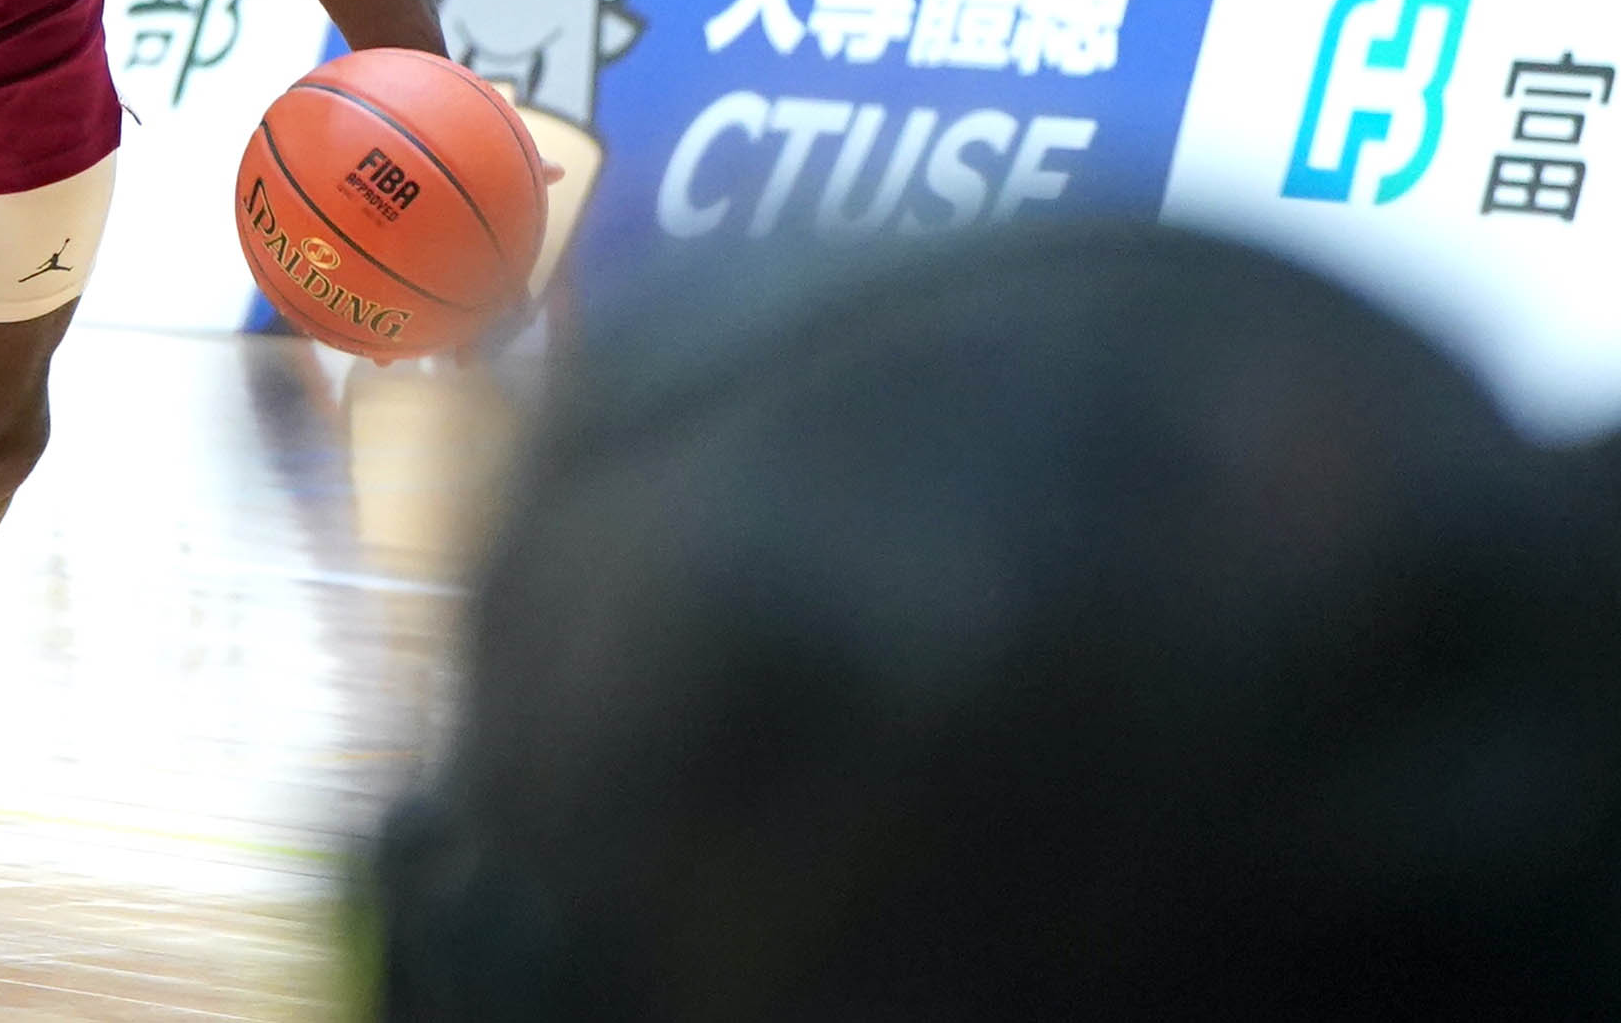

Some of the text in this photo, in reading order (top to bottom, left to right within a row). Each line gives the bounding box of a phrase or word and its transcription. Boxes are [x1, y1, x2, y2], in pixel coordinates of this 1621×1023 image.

[357, 147, 421, 211] FIBA
[1481, 51, 1616, 222] 富
[346, 172, 399, 223] APPROVED
[244, 176, 414, 341] SPALDING
